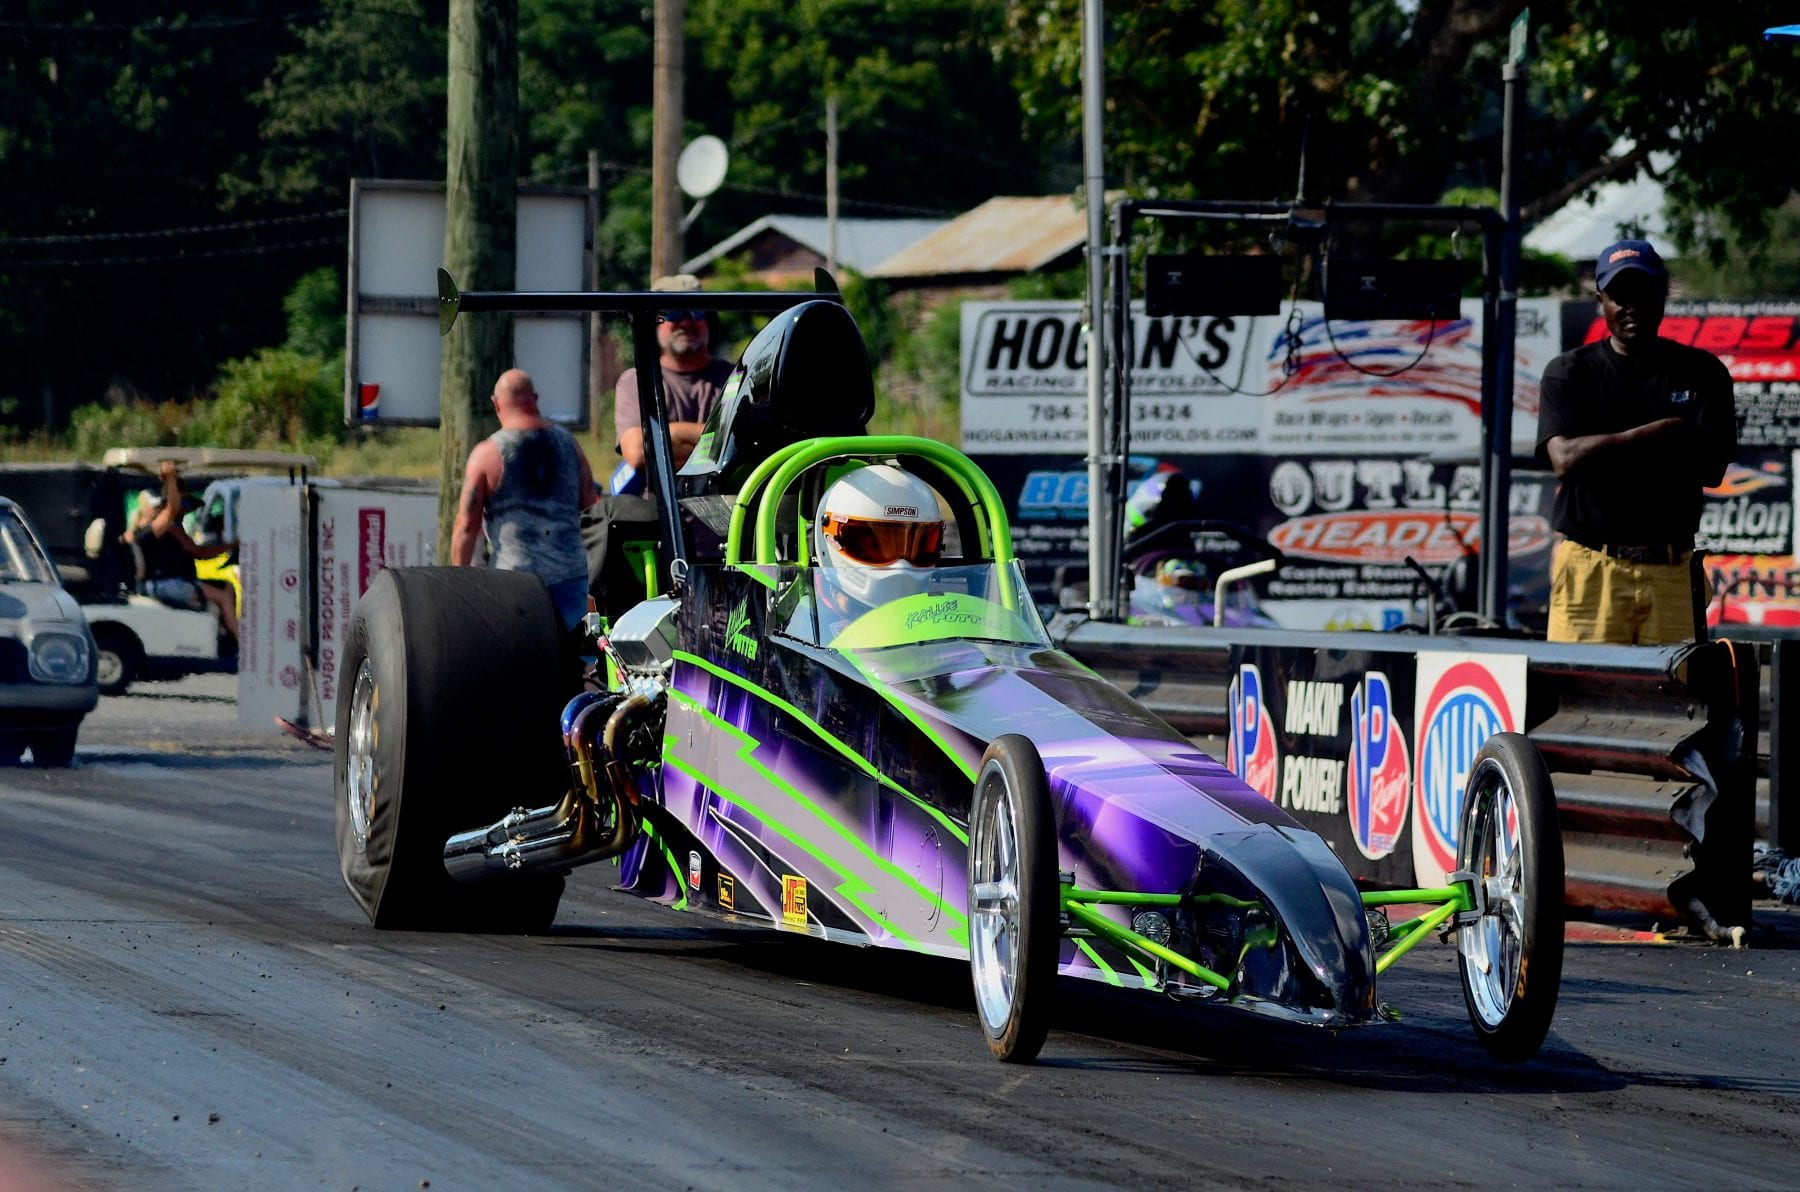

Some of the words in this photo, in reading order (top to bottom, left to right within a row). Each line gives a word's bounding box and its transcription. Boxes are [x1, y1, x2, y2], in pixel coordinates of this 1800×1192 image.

[986, 316, 1235, 371] HOGN'S
[1030, 403, 1192, 421] 704-3424
[321, 516, 335, 550] INC.
[886, 507, 917, 516] SIMPSON
[1285, 680, 1343, 737] MAKIN'
[1281, 755, 1344, 813] POWER!
[1350, 671, 1393, 851] VP
[1430, 701, 1504, 843] NH
